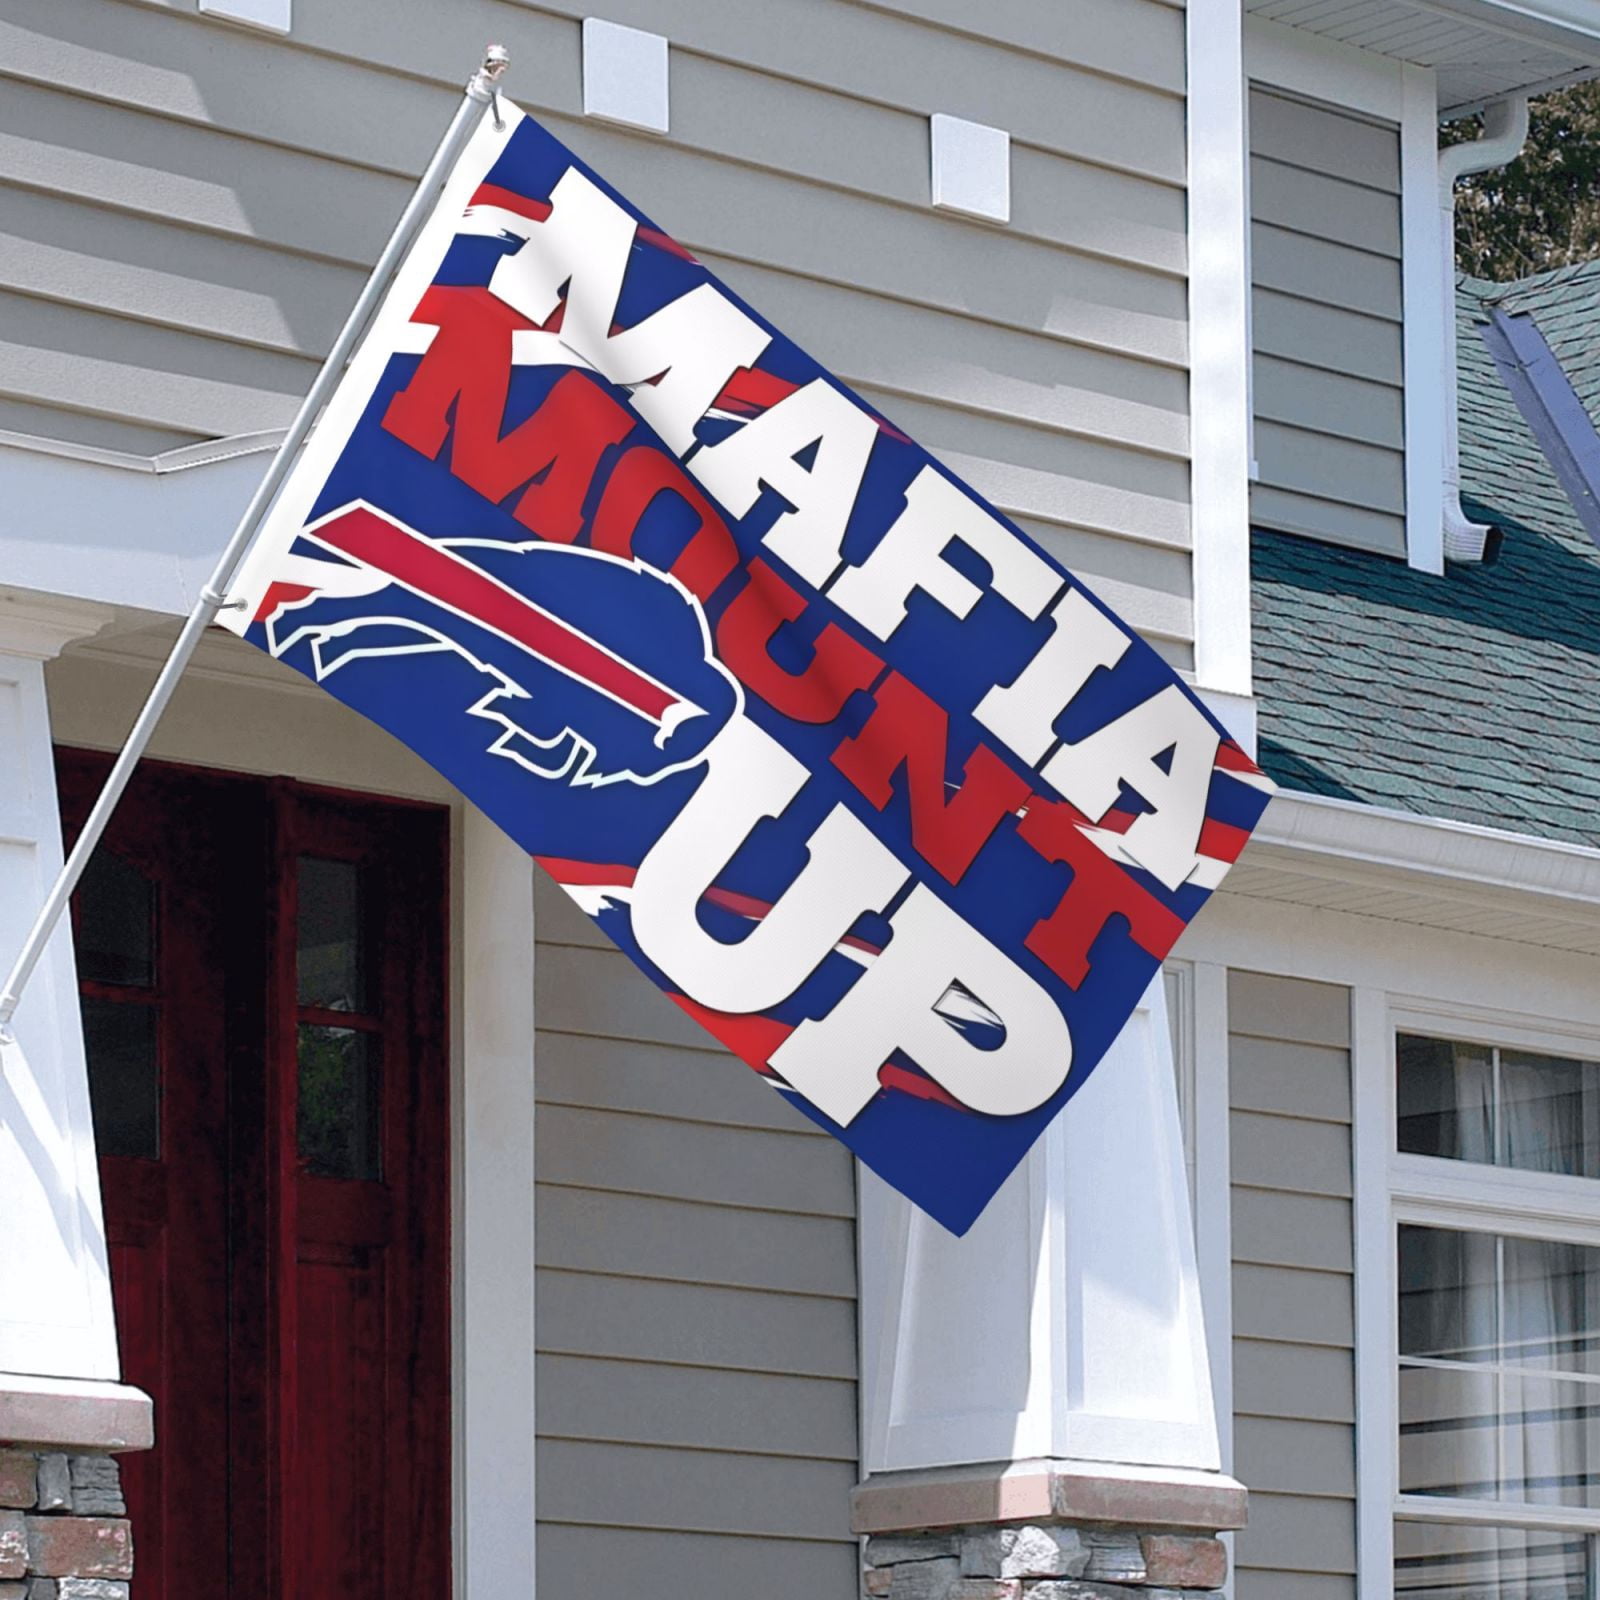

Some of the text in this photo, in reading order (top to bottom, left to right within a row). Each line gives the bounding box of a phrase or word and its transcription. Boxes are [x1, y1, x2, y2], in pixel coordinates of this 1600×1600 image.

[381, 287, 1188, 991] MOUNT
[488, 165, 1228, 891] MAFIA
[630, 713, 1073, 1128] UP
